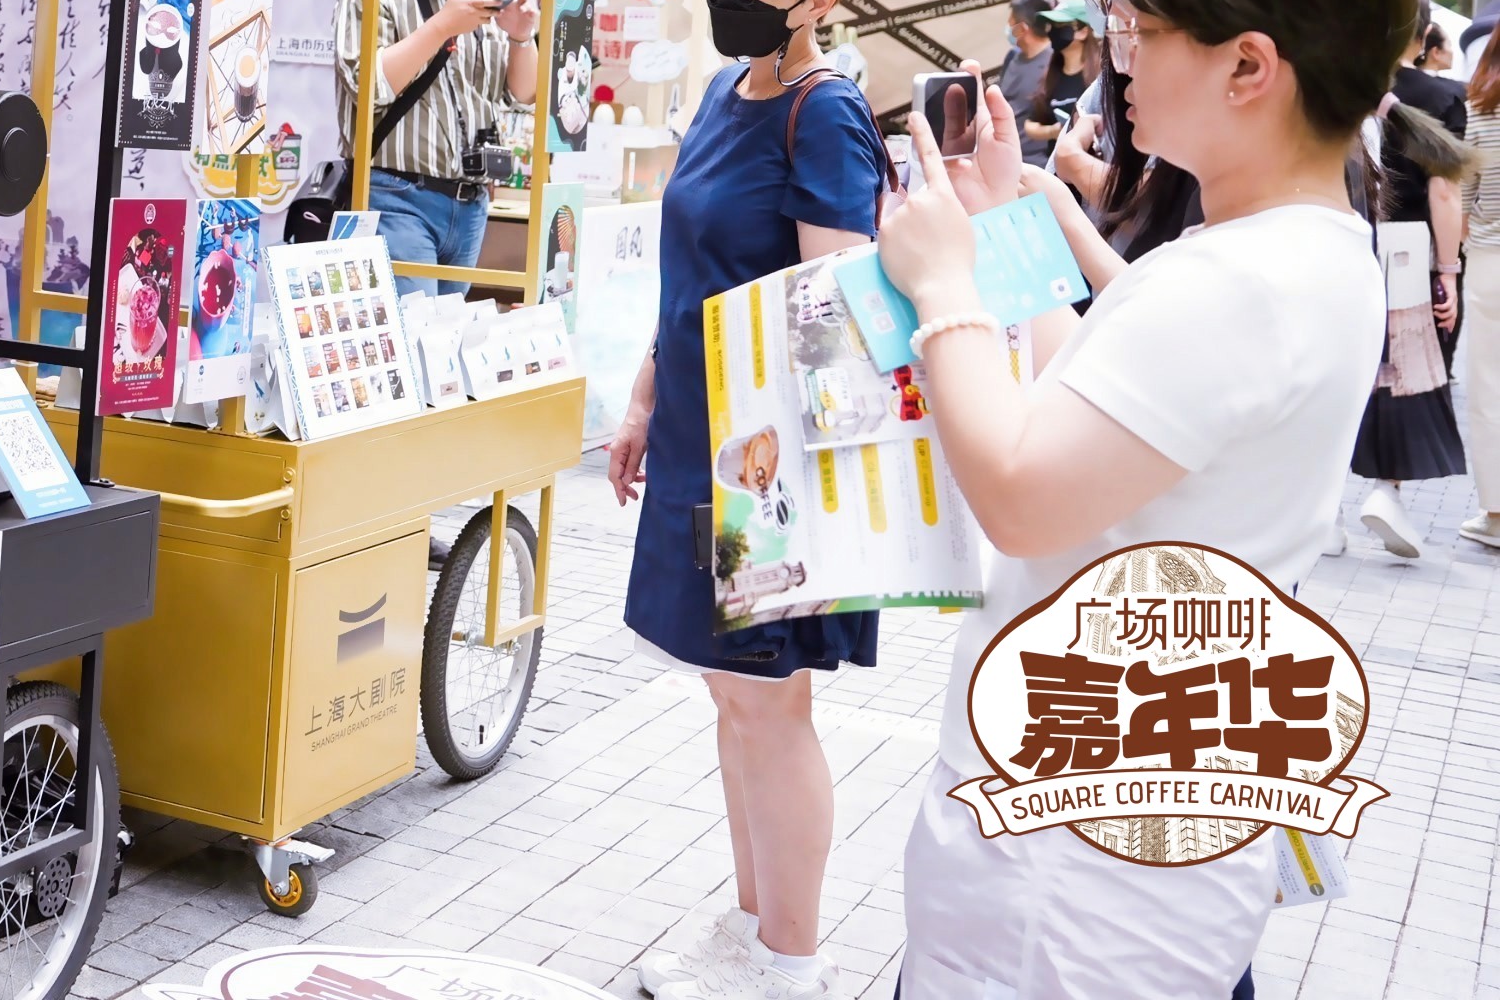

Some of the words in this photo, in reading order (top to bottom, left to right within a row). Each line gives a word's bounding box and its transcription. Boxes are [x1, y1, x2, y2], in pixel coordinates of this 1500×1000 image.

[304, 667, 406, 737] 上海大剧院
[311, 728, 347, 752] SHANGHAI
[347, 716, 370, 736] GRAND
[370, 703, 398, 725] THEATRE
